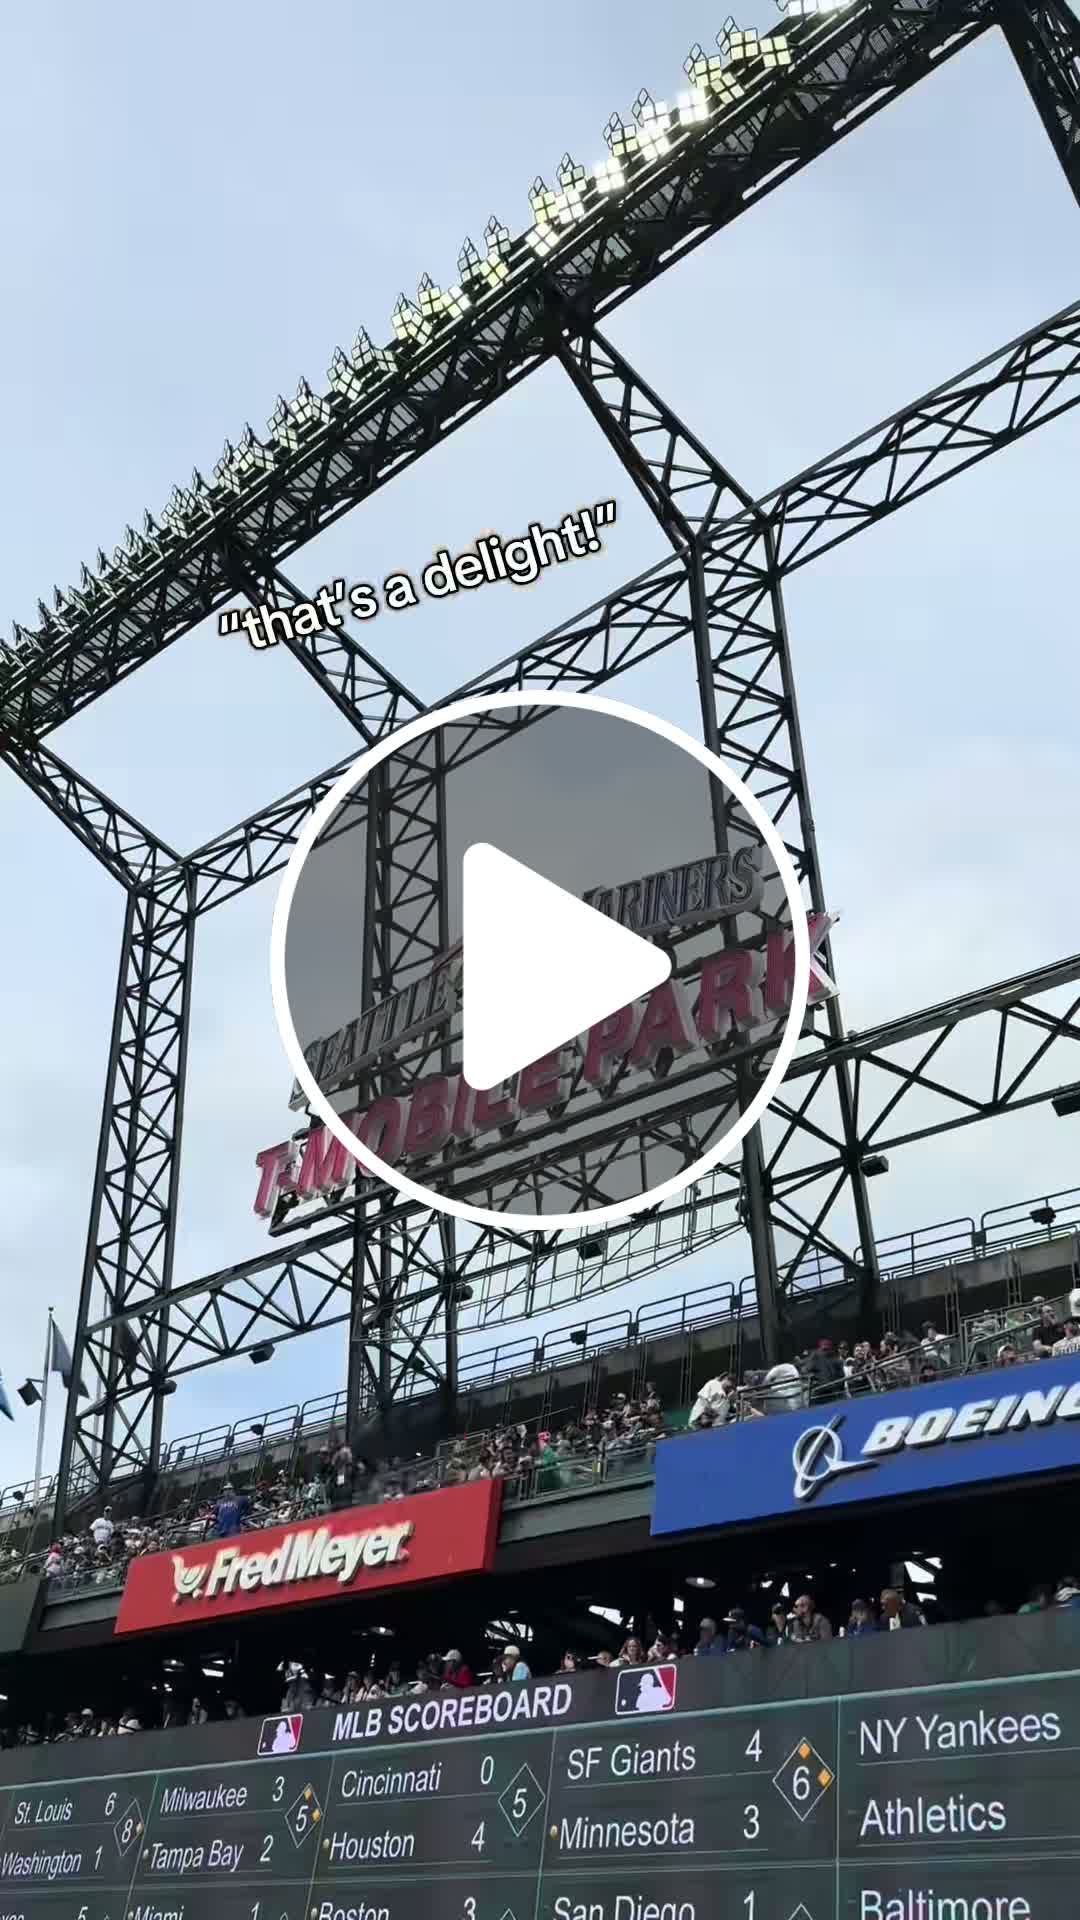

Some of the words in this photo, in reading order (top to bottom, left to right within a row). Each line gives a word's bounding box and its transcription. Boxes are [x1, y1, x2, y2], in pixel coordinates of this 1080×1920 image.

[582, 911, 842, 1088] PARK
[333, 1709, 381, 1741] MLB
[388, 1684, 572, 1735] SCOREBOARD
[860, 1717, 908, 1756] NY
[915, 1710, 1061, 1750] Yankees
[567, 1747, 602, 1781] SF
[611, 1740, 696, 1774] Giants
[745, 1729, 763, 1762] 4
[160, 1786, 248, 1813] Milwaukee
[272, 1776, 285, 1802] 3
[341, 1762, 442, 1798] Cincinnati
[480, 1756, 495, 1785] 0
[792, 1766, 810, 1801] 6
[14, 1801, 31, 1824] St.
[35, 1797, 73, 1823] Louis
[104, 1792, 117, 1816] 6
[295, 1806, 309, 1833] 5
[512, 1787, 527, 1818] 5
[860, 1794, 1007, 1837] Athletics
[121, 1818, 134, 1844] 8
[328, 1830, 415, 1861] Houston
[470, 1821, 486, 1852] 4
[559, 1813, 695, 1850] Minnesota
[743, 1804, 760, 1839] 3
[1, 1850, 82, 1881] Washington
[94, 1845, 104, 1871] 1
[150, 1842, 204, 1875] Tampa
[208, 1839, 244, 1873] Bay
[260, 1834, 274, 1863] 2
[249, 1901, 261, 1920] 1
[319, 1902, 390, 1920] Boston
[553, 1896, 605, 1920] San
[614, 1895, 696, 1920] Diego
[743, 1890, 755, 1920] 1
[860, 1889, 1031, 1920] Baltimore
